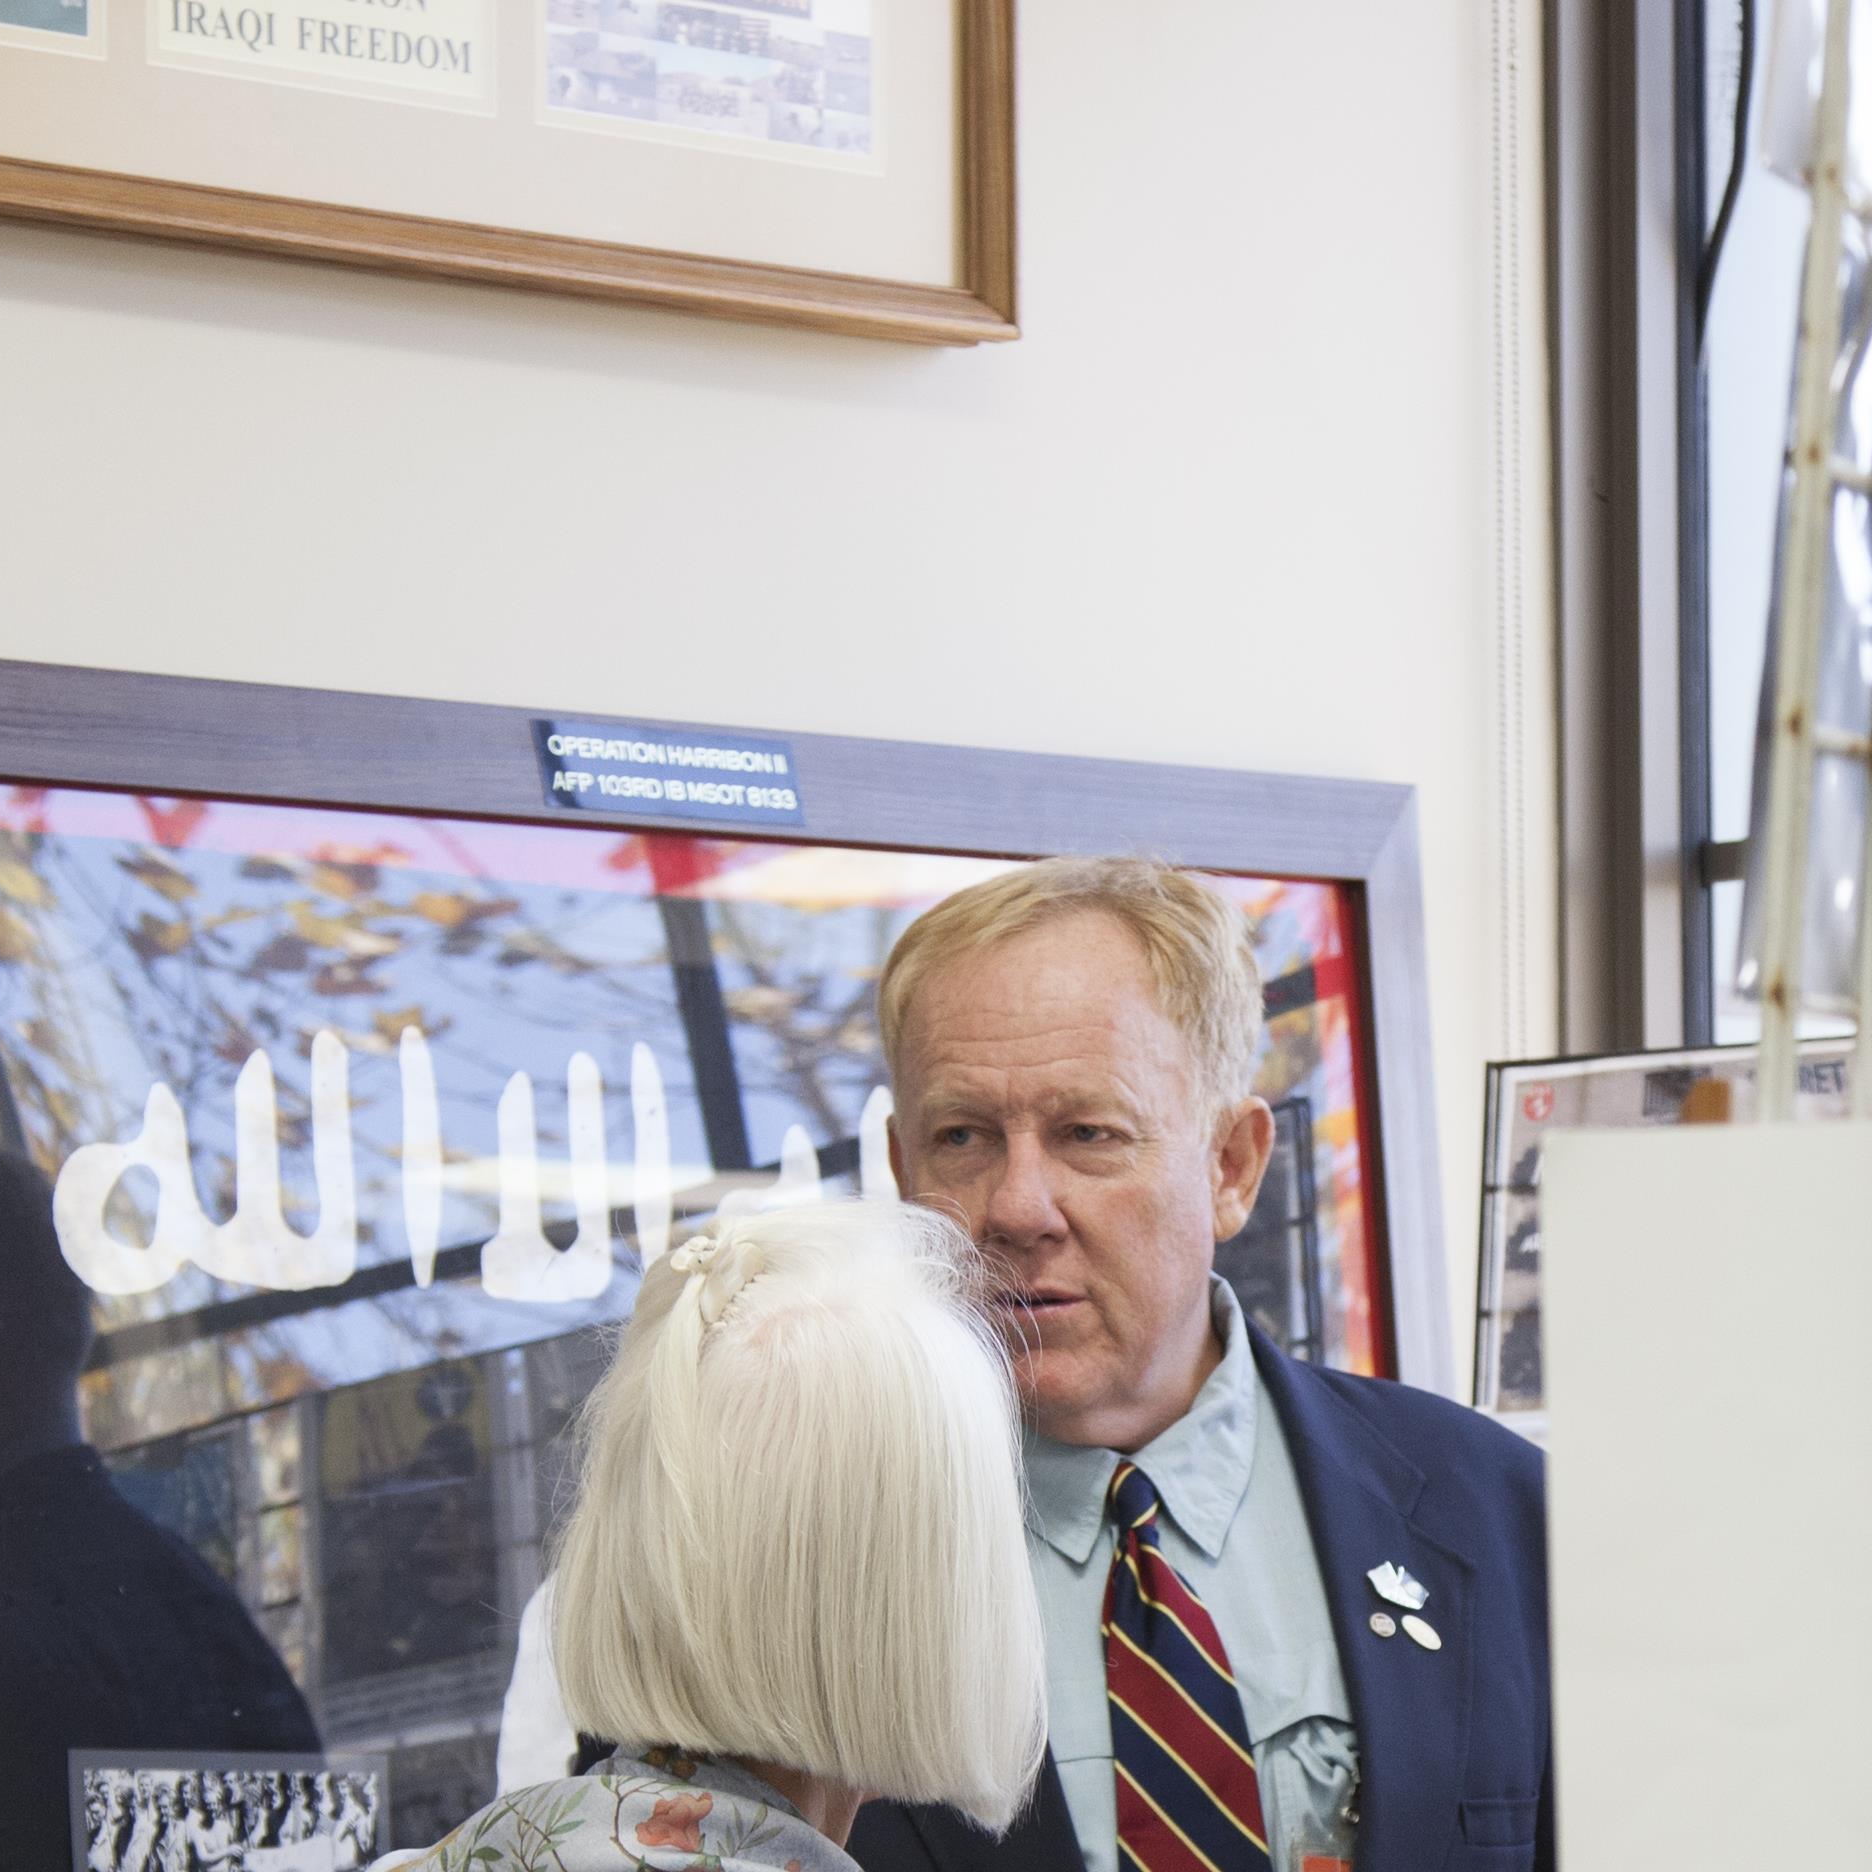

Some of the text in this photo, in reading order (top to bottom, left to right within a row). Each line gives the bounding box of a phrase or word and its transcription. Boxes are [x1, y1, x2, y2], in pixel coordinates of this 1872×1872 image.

[170, 0, 473, 74] IRAQI FREEDOM
[548, 735, 664, 765] OPERATION
[774, 754, 788, 775] II
[553, 771, 797, 810] AFP 103RD IB MSOT 8133
